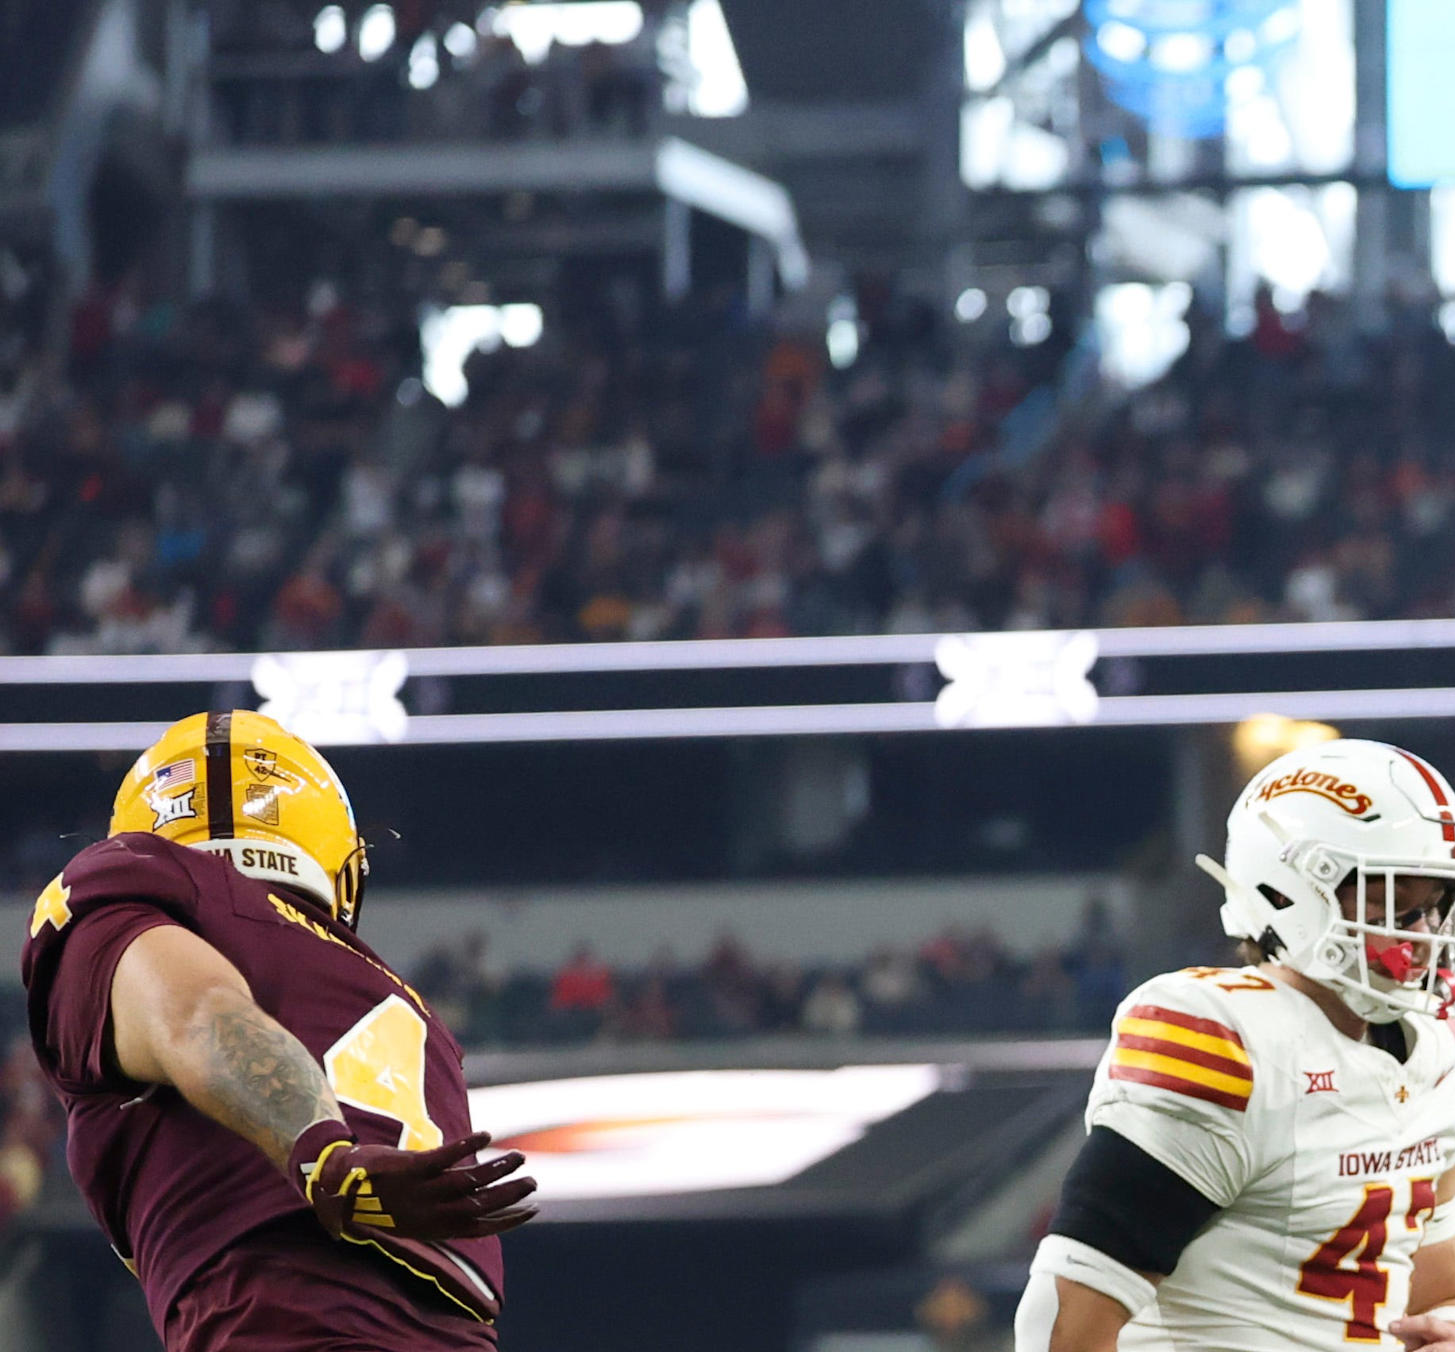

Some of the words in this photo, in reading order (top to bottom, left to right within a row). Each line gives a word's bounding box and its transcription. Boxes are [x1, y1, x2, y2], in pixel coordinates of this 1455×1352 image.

[1254, 766, 1374, 816] yclones
[242, 848, 299, 876] STATE
[1303, 1070, 1340, 1095] XII
[1338, 1152, 1391, 1176] IOWA
